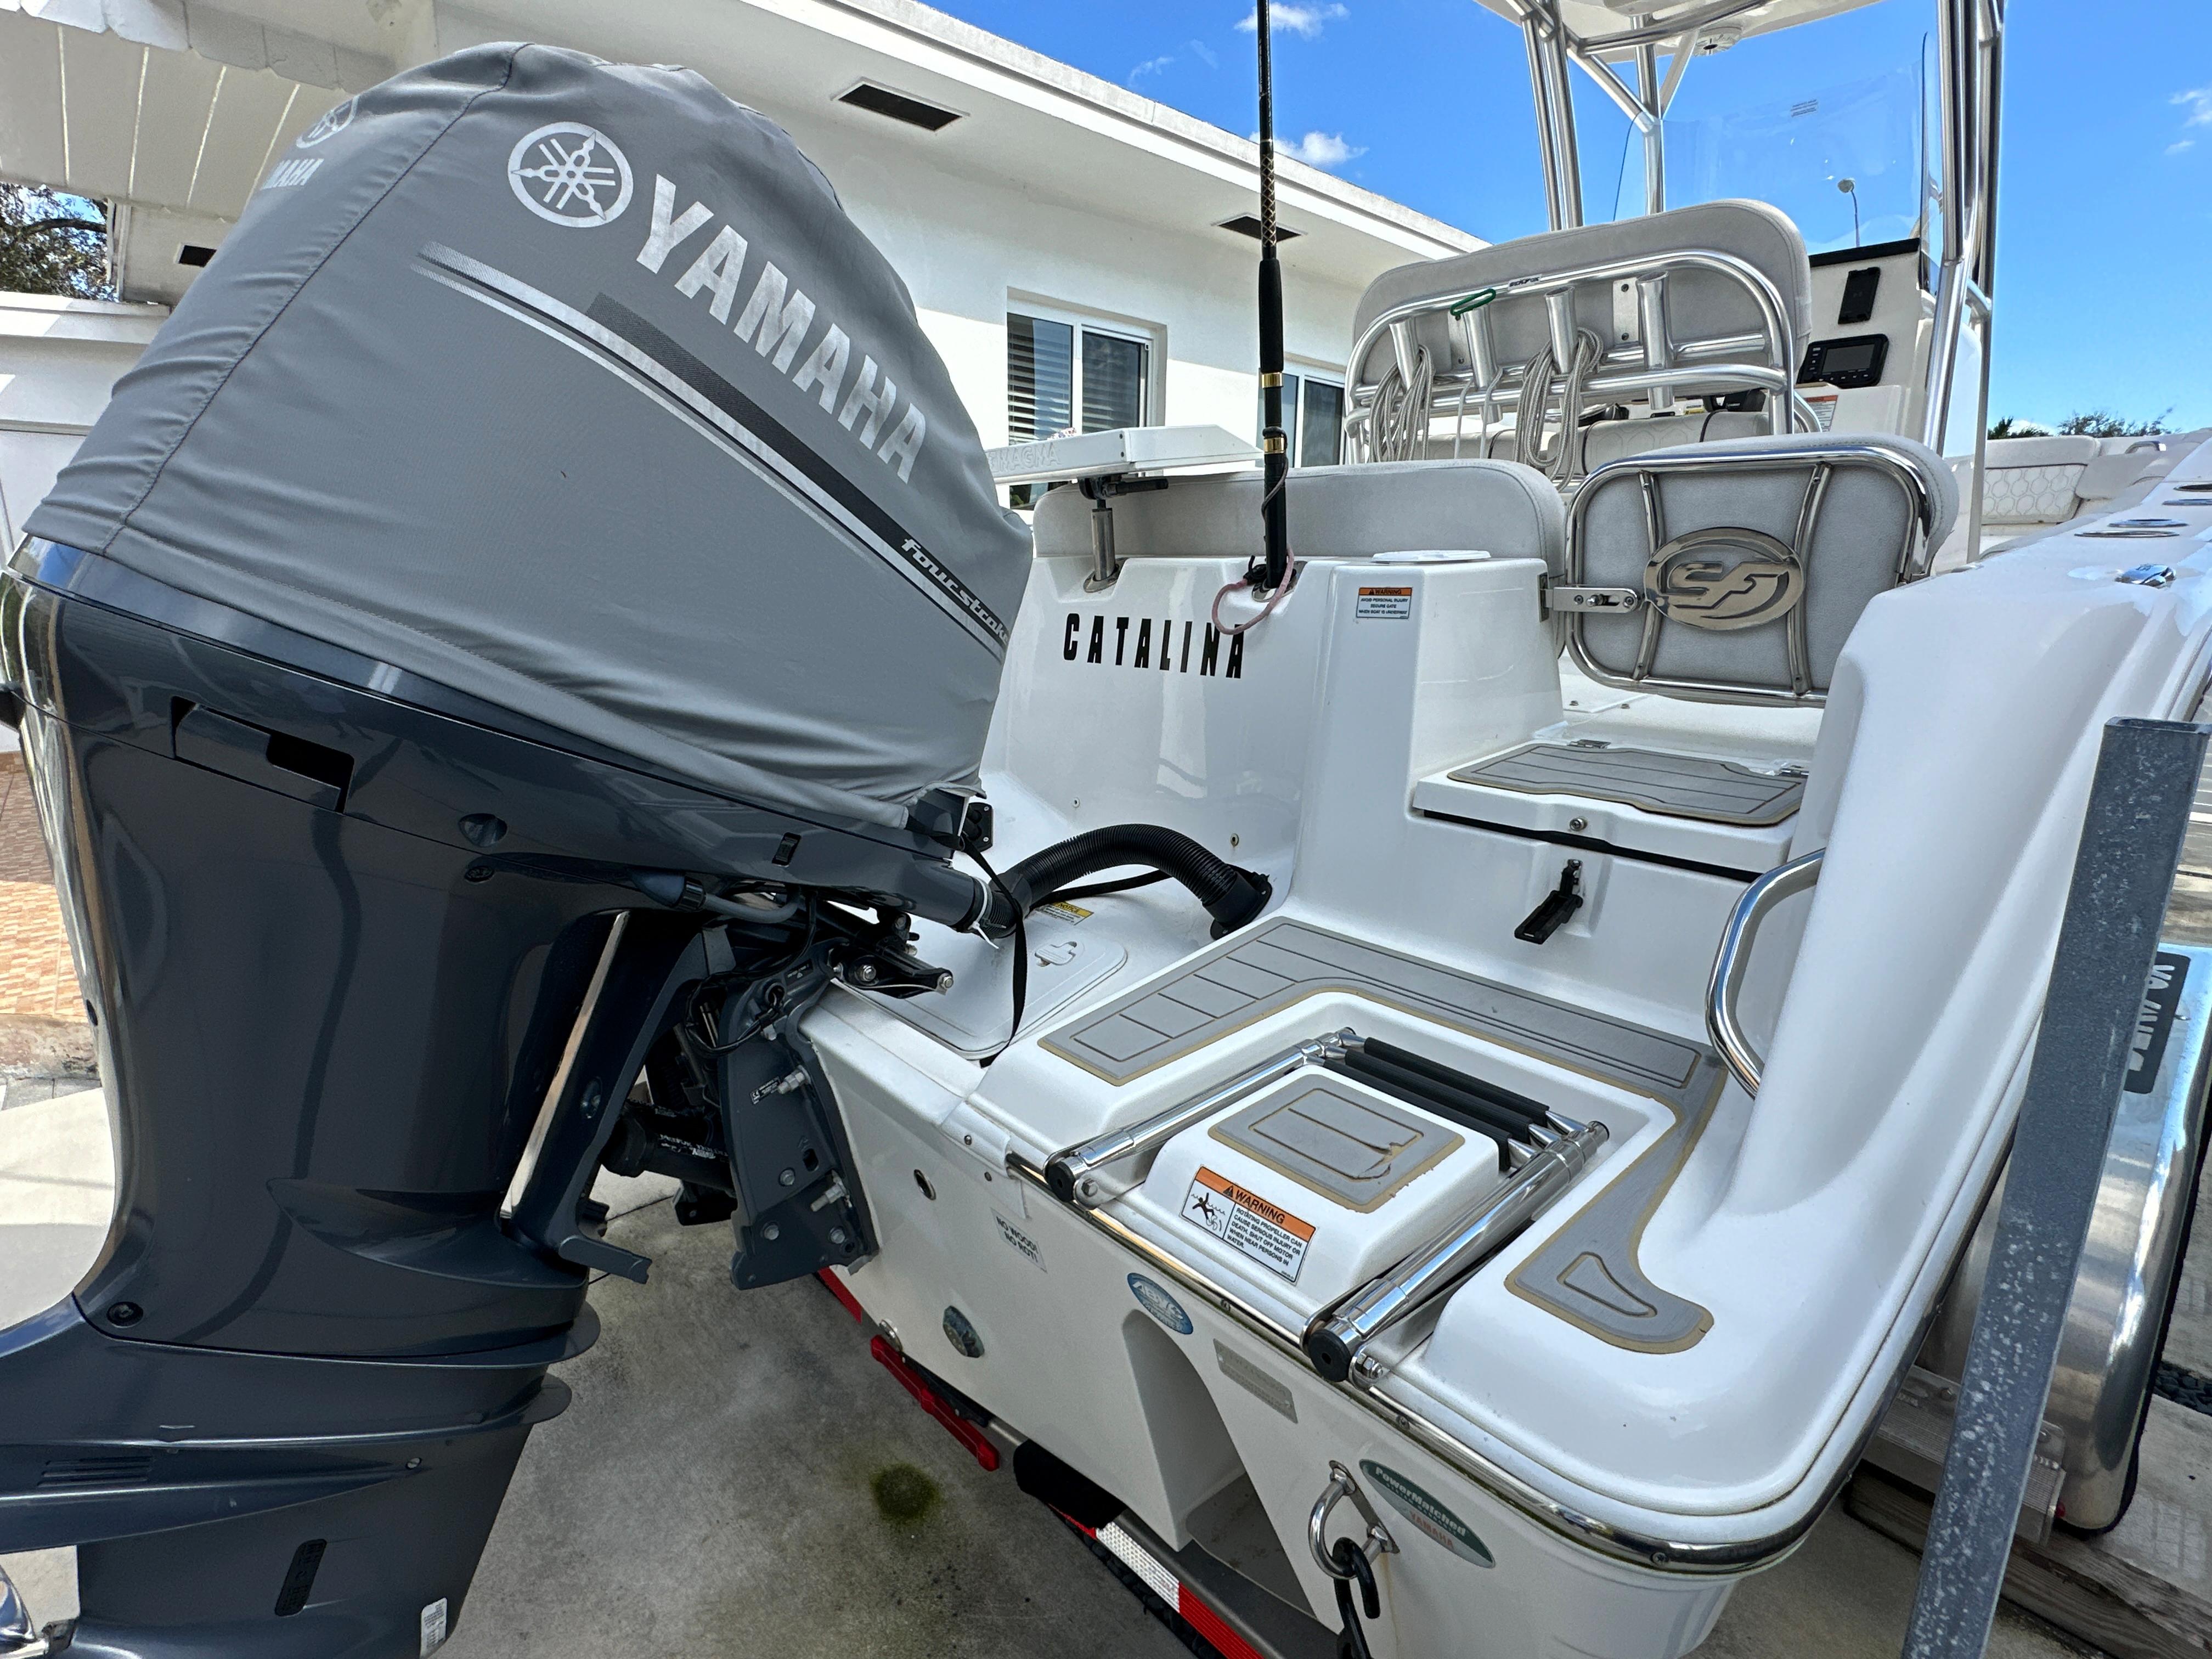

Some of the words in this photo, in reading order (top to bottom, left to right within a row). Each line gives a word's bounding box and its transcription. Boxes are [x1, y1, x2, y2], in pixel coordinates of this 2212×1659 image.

[636, 174, 926, 484] YAMAHA
[1063, 613, 1244, 679] CATALINA
[996, 1216, 1008, 1231] NO
[1235, 1190, 1285, 1225] WARNING
[1004, 1231, 1017, 1246] NO
[1226, 1234, 1245, 1249] WATER.
[1229, 1227, 1245, 1240] WHEN
[1244, 1235, 1259, 1249] NEAR
[1258, 1244, 1283, 1263] PERSONS
[1283, 1258, 1289, 1266] IN
[1234, 1215, 1250, 1227] CAUSE
[1250, 1223, 1273, 1240] SERIOUS
[1273, 1235, 1292, 1249] INJURY
[1291, 1246, 1301, 1256] OR
[1236, 1207, 1261, 1224] ROTATING
[1261, 1220, 1290, 1242] PROPELLER
[1290, 1236, 1303, 1248] CAN
[1249, 1230, 1263, 1243] SHUT
[1262, 1238, 1273, 1248] OFF
[1273, 1243, 1294, 1260] MOTOR
[1409, 1510, 1454, 1549] YAMAHA
